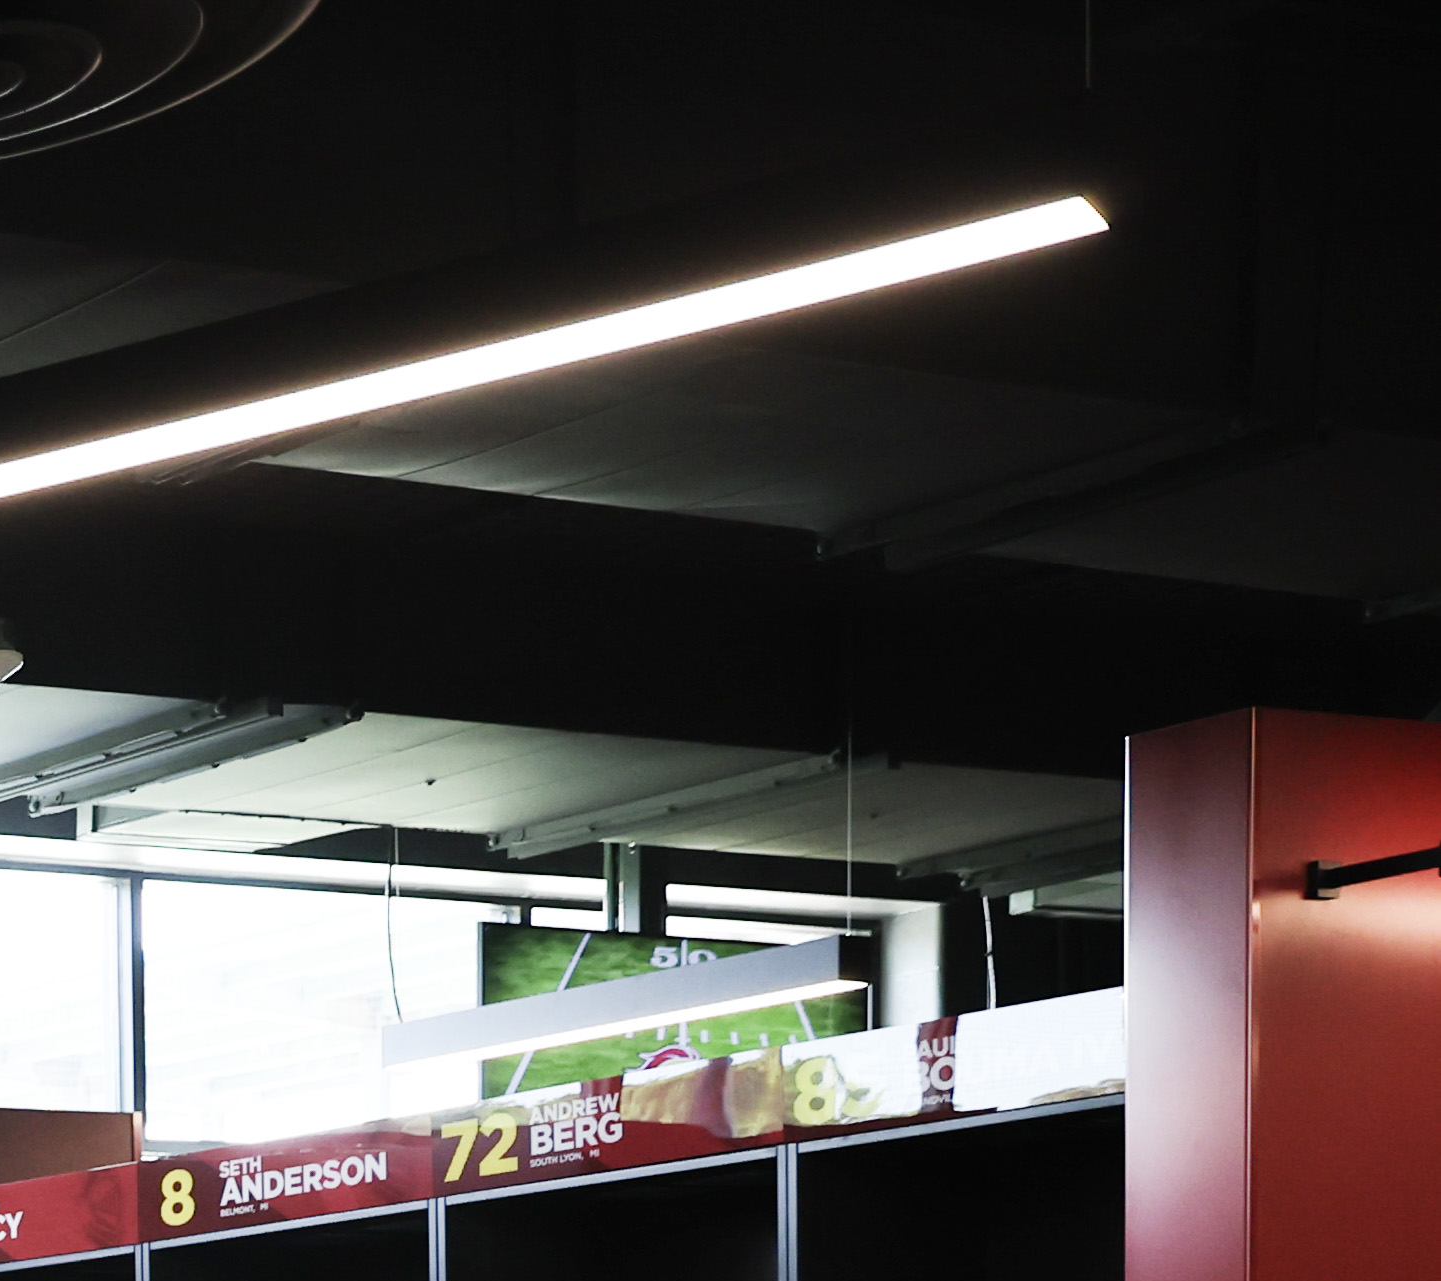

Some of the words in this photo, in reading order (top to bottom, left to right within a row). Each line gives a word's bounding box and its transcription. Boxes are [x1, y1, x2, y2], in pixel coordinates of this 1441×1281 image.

[529, 1092, 620, 1125] ANDREW
[441, 1113, 518, 1183] 72
[530, 1112, 623, 1155] BERG
[219, 1155, 262, 1178] SETH
[219, 1151, 388, 1207] ANDERSON
[529, 1155, 558, 1168] SOUTH
[161, 1168, 195, 1226] 8
